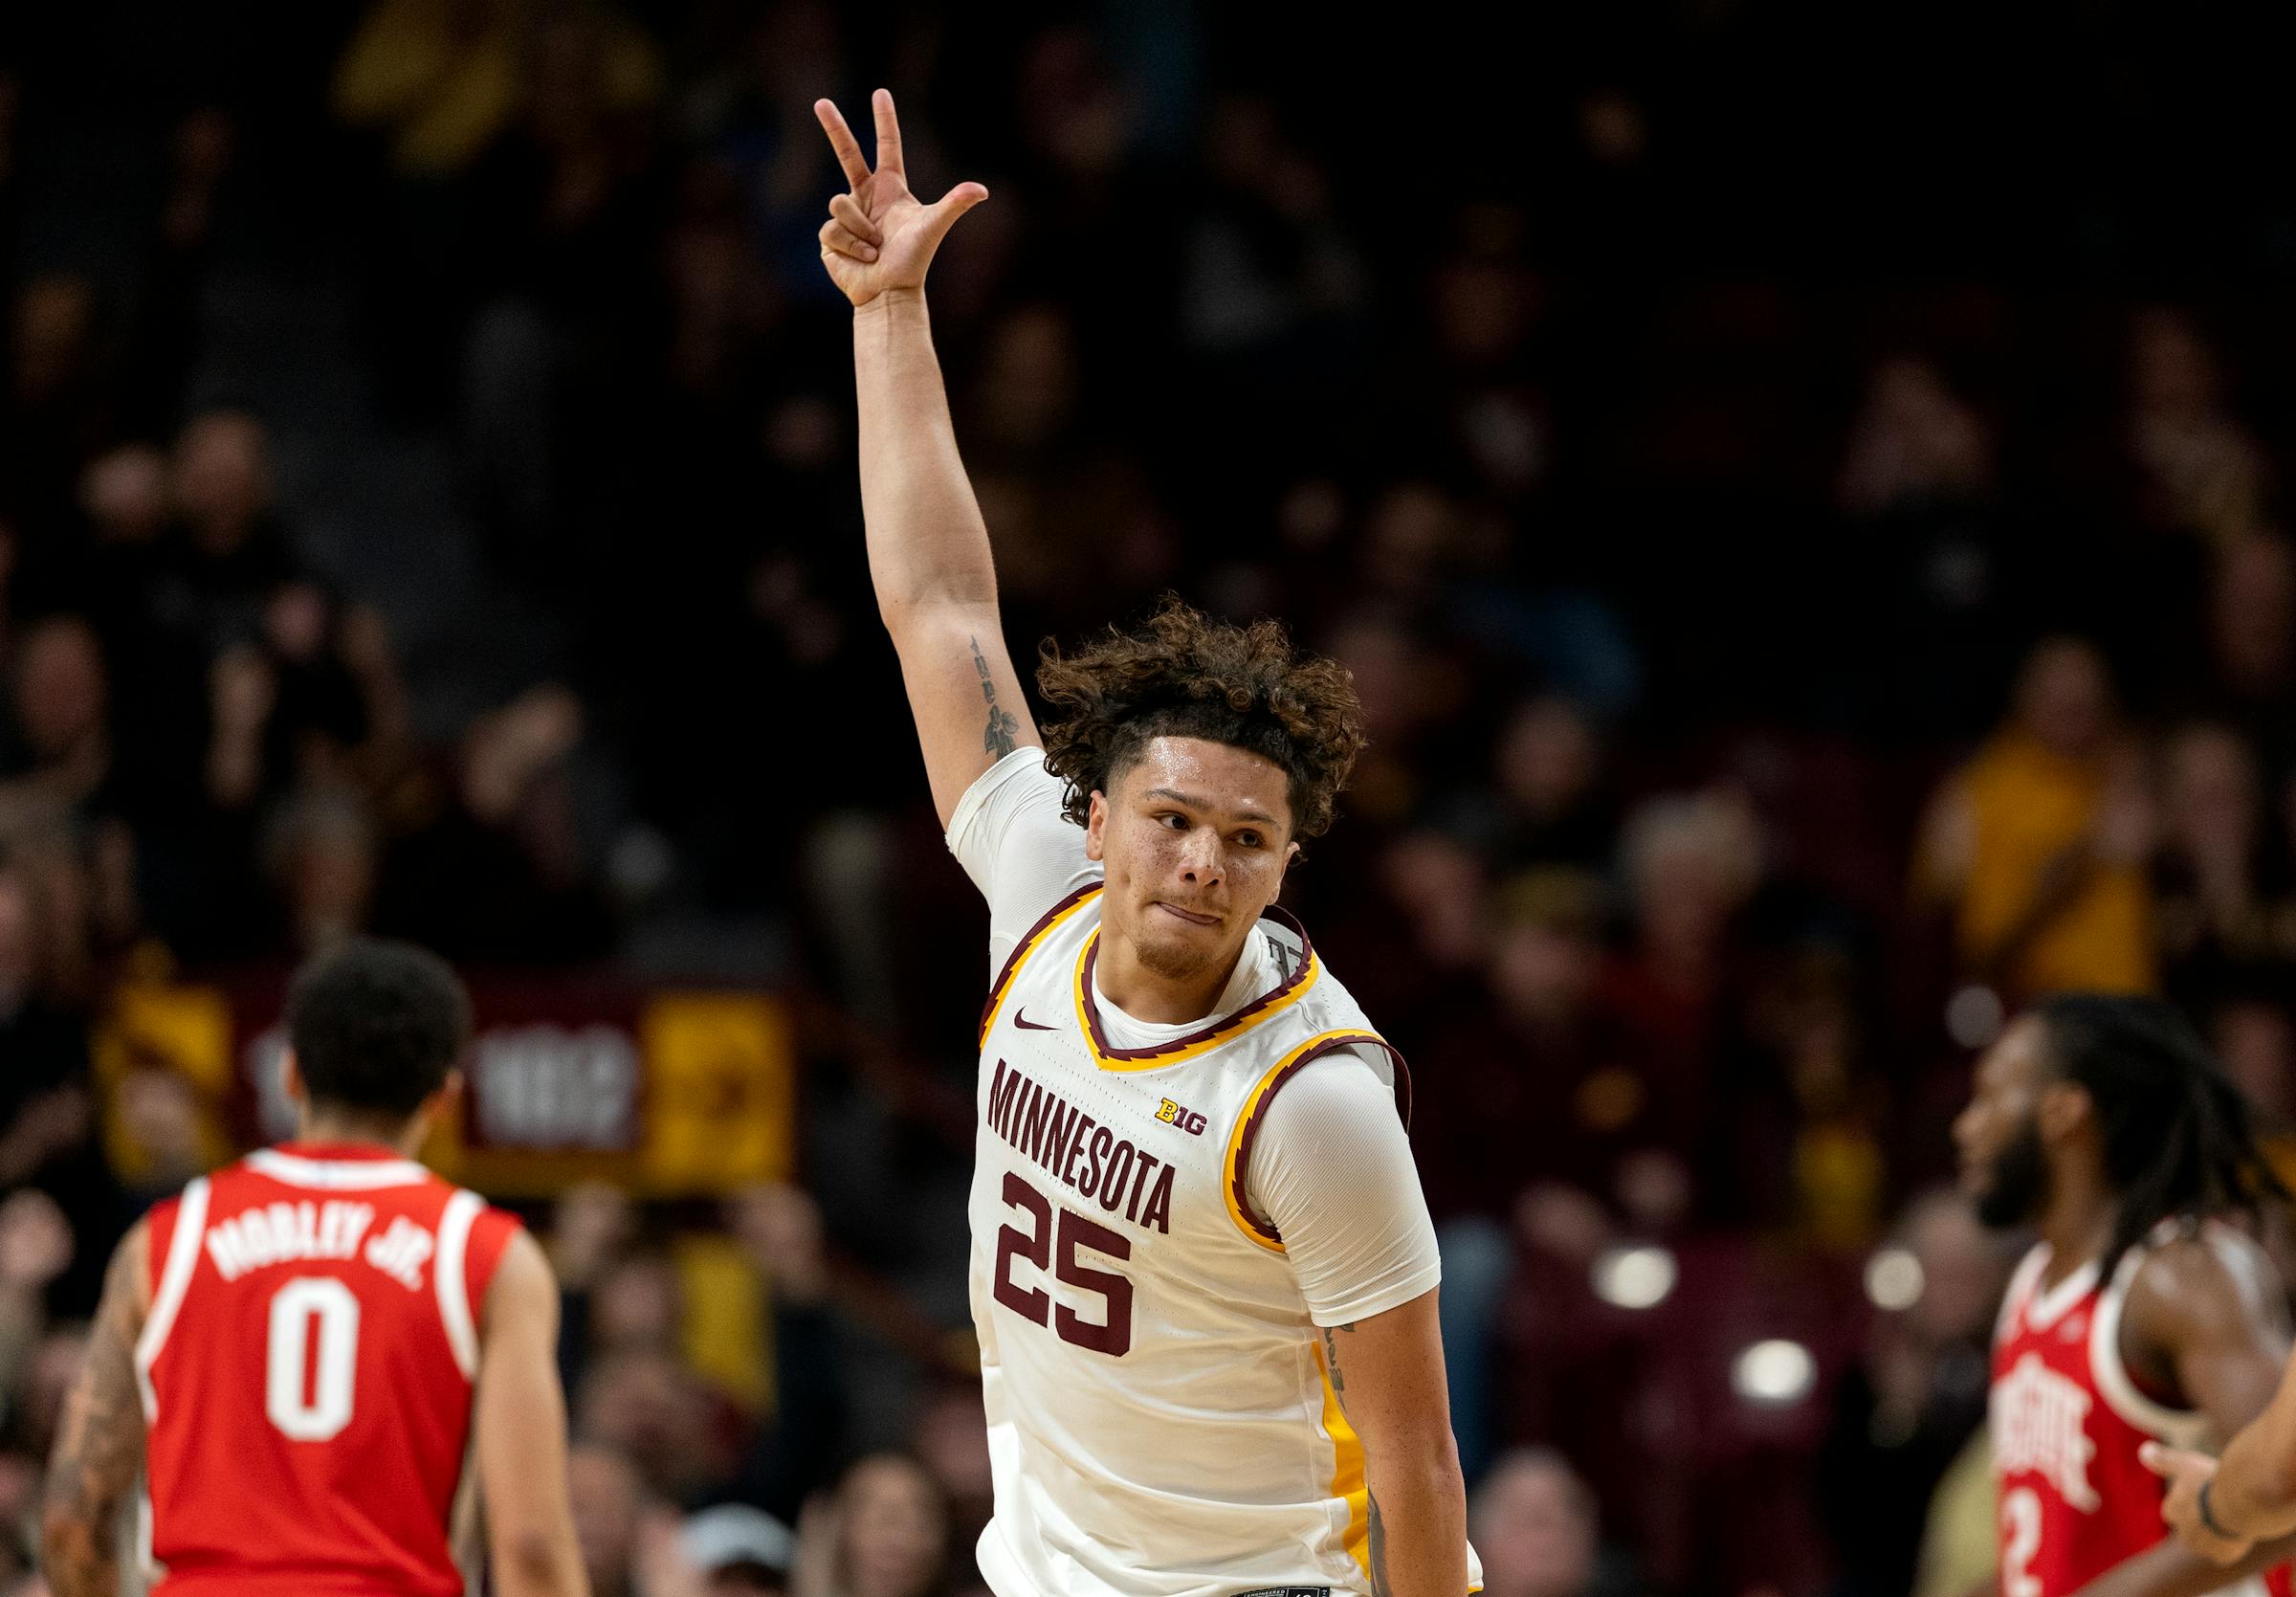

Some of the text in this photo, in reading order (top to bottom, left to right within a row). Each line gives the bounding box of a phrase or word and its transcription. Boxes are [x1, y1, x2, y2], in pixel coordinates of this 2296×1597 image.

[987, 1057, 1176, 1234] MINNESOTA
[993, 1170, 1134, 1357] 25
[265, 1275, 361, 1442] 0
